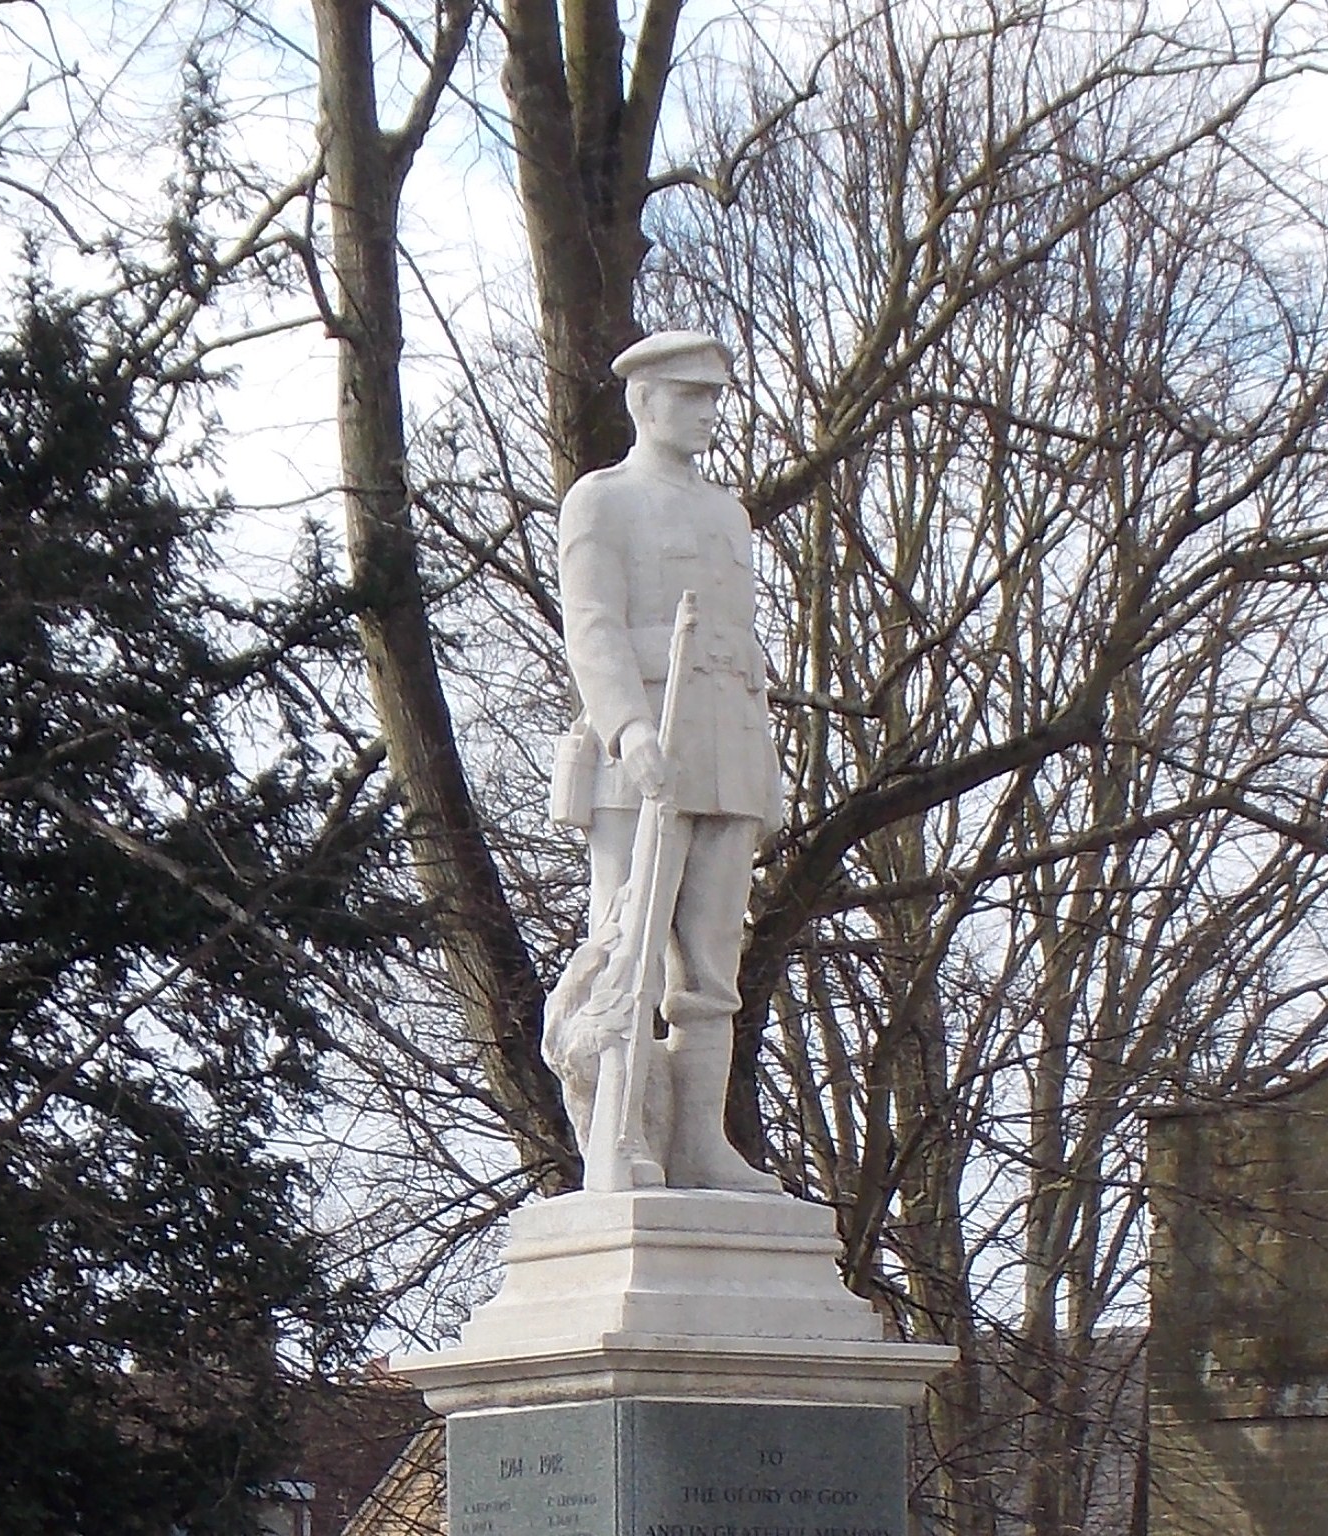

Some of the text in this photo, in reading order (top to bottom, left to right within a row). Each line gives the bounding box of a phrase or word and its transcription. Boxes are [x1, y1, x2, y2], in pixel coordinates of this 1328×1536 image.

[760, 1451, 784, 1466] TO
[681, 1486, 859, 1505] THE GLORY OF GOD
